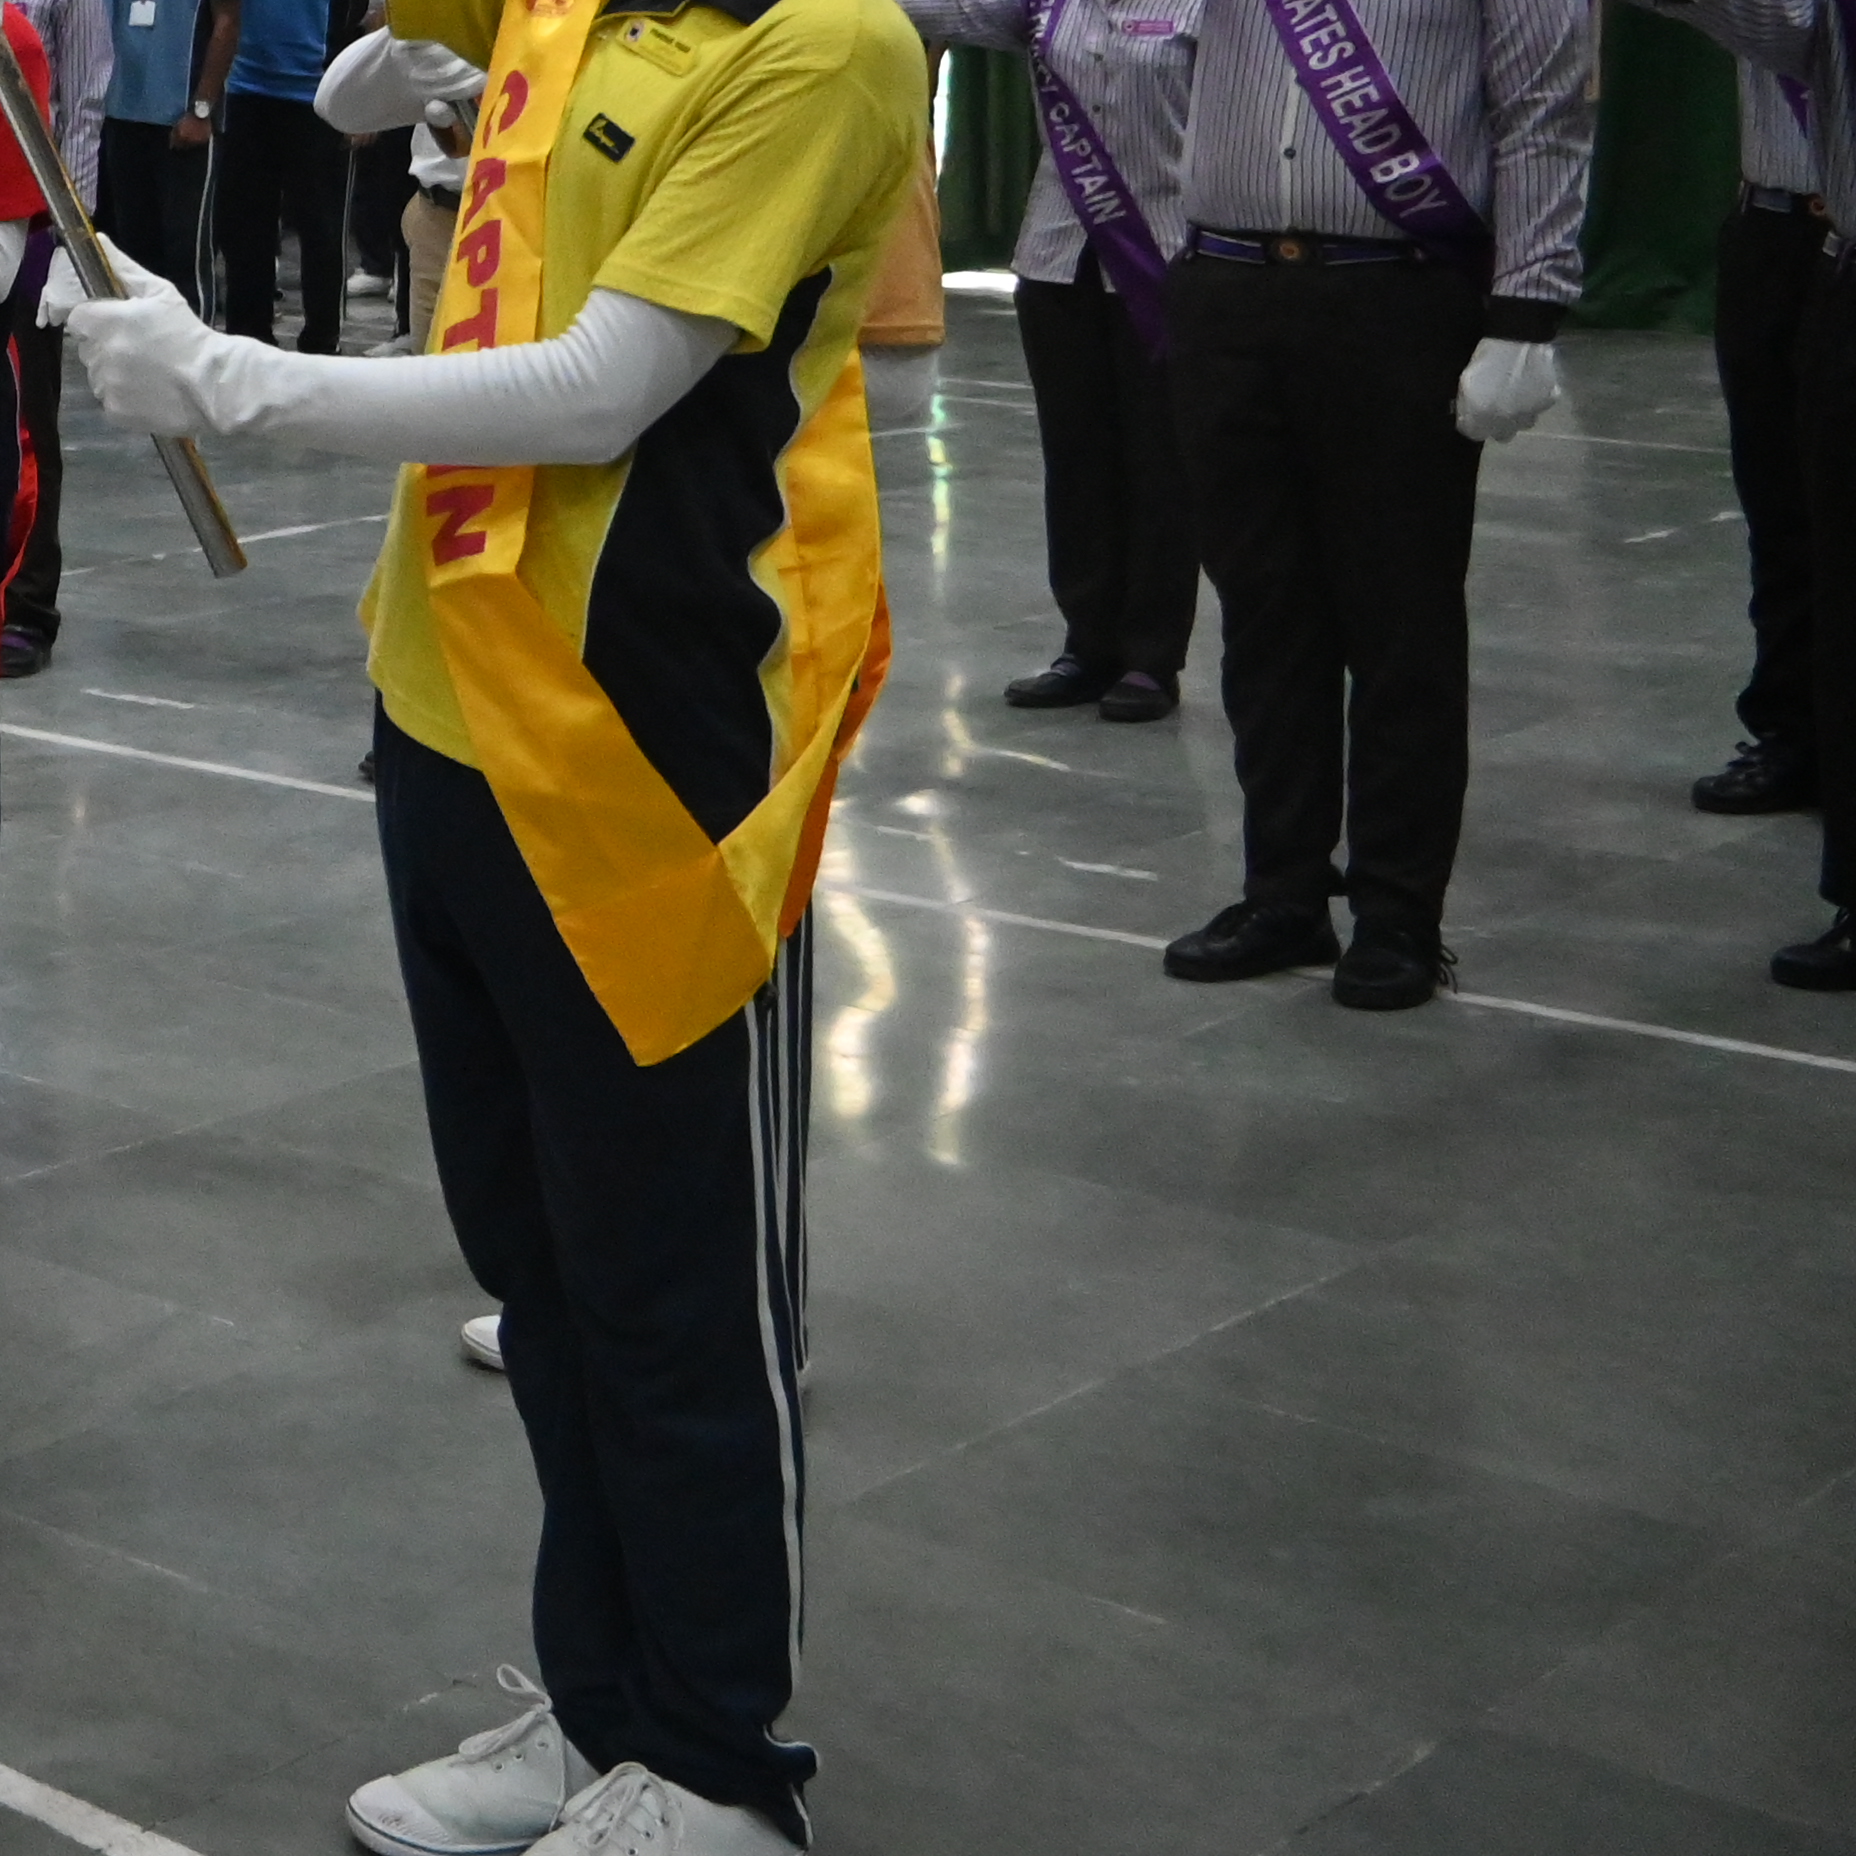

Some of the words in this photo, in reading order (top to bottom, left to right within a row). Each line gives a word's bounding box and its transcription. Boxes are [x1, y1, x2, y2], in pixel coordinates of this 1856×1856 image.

[1049, 101, 1127, 225] CAPTAIN
[1320, 65, 1403, 155] HEAD
[1369, 150, 1448, 219] BOY
[427, 70, 529, 567] CAPTN
